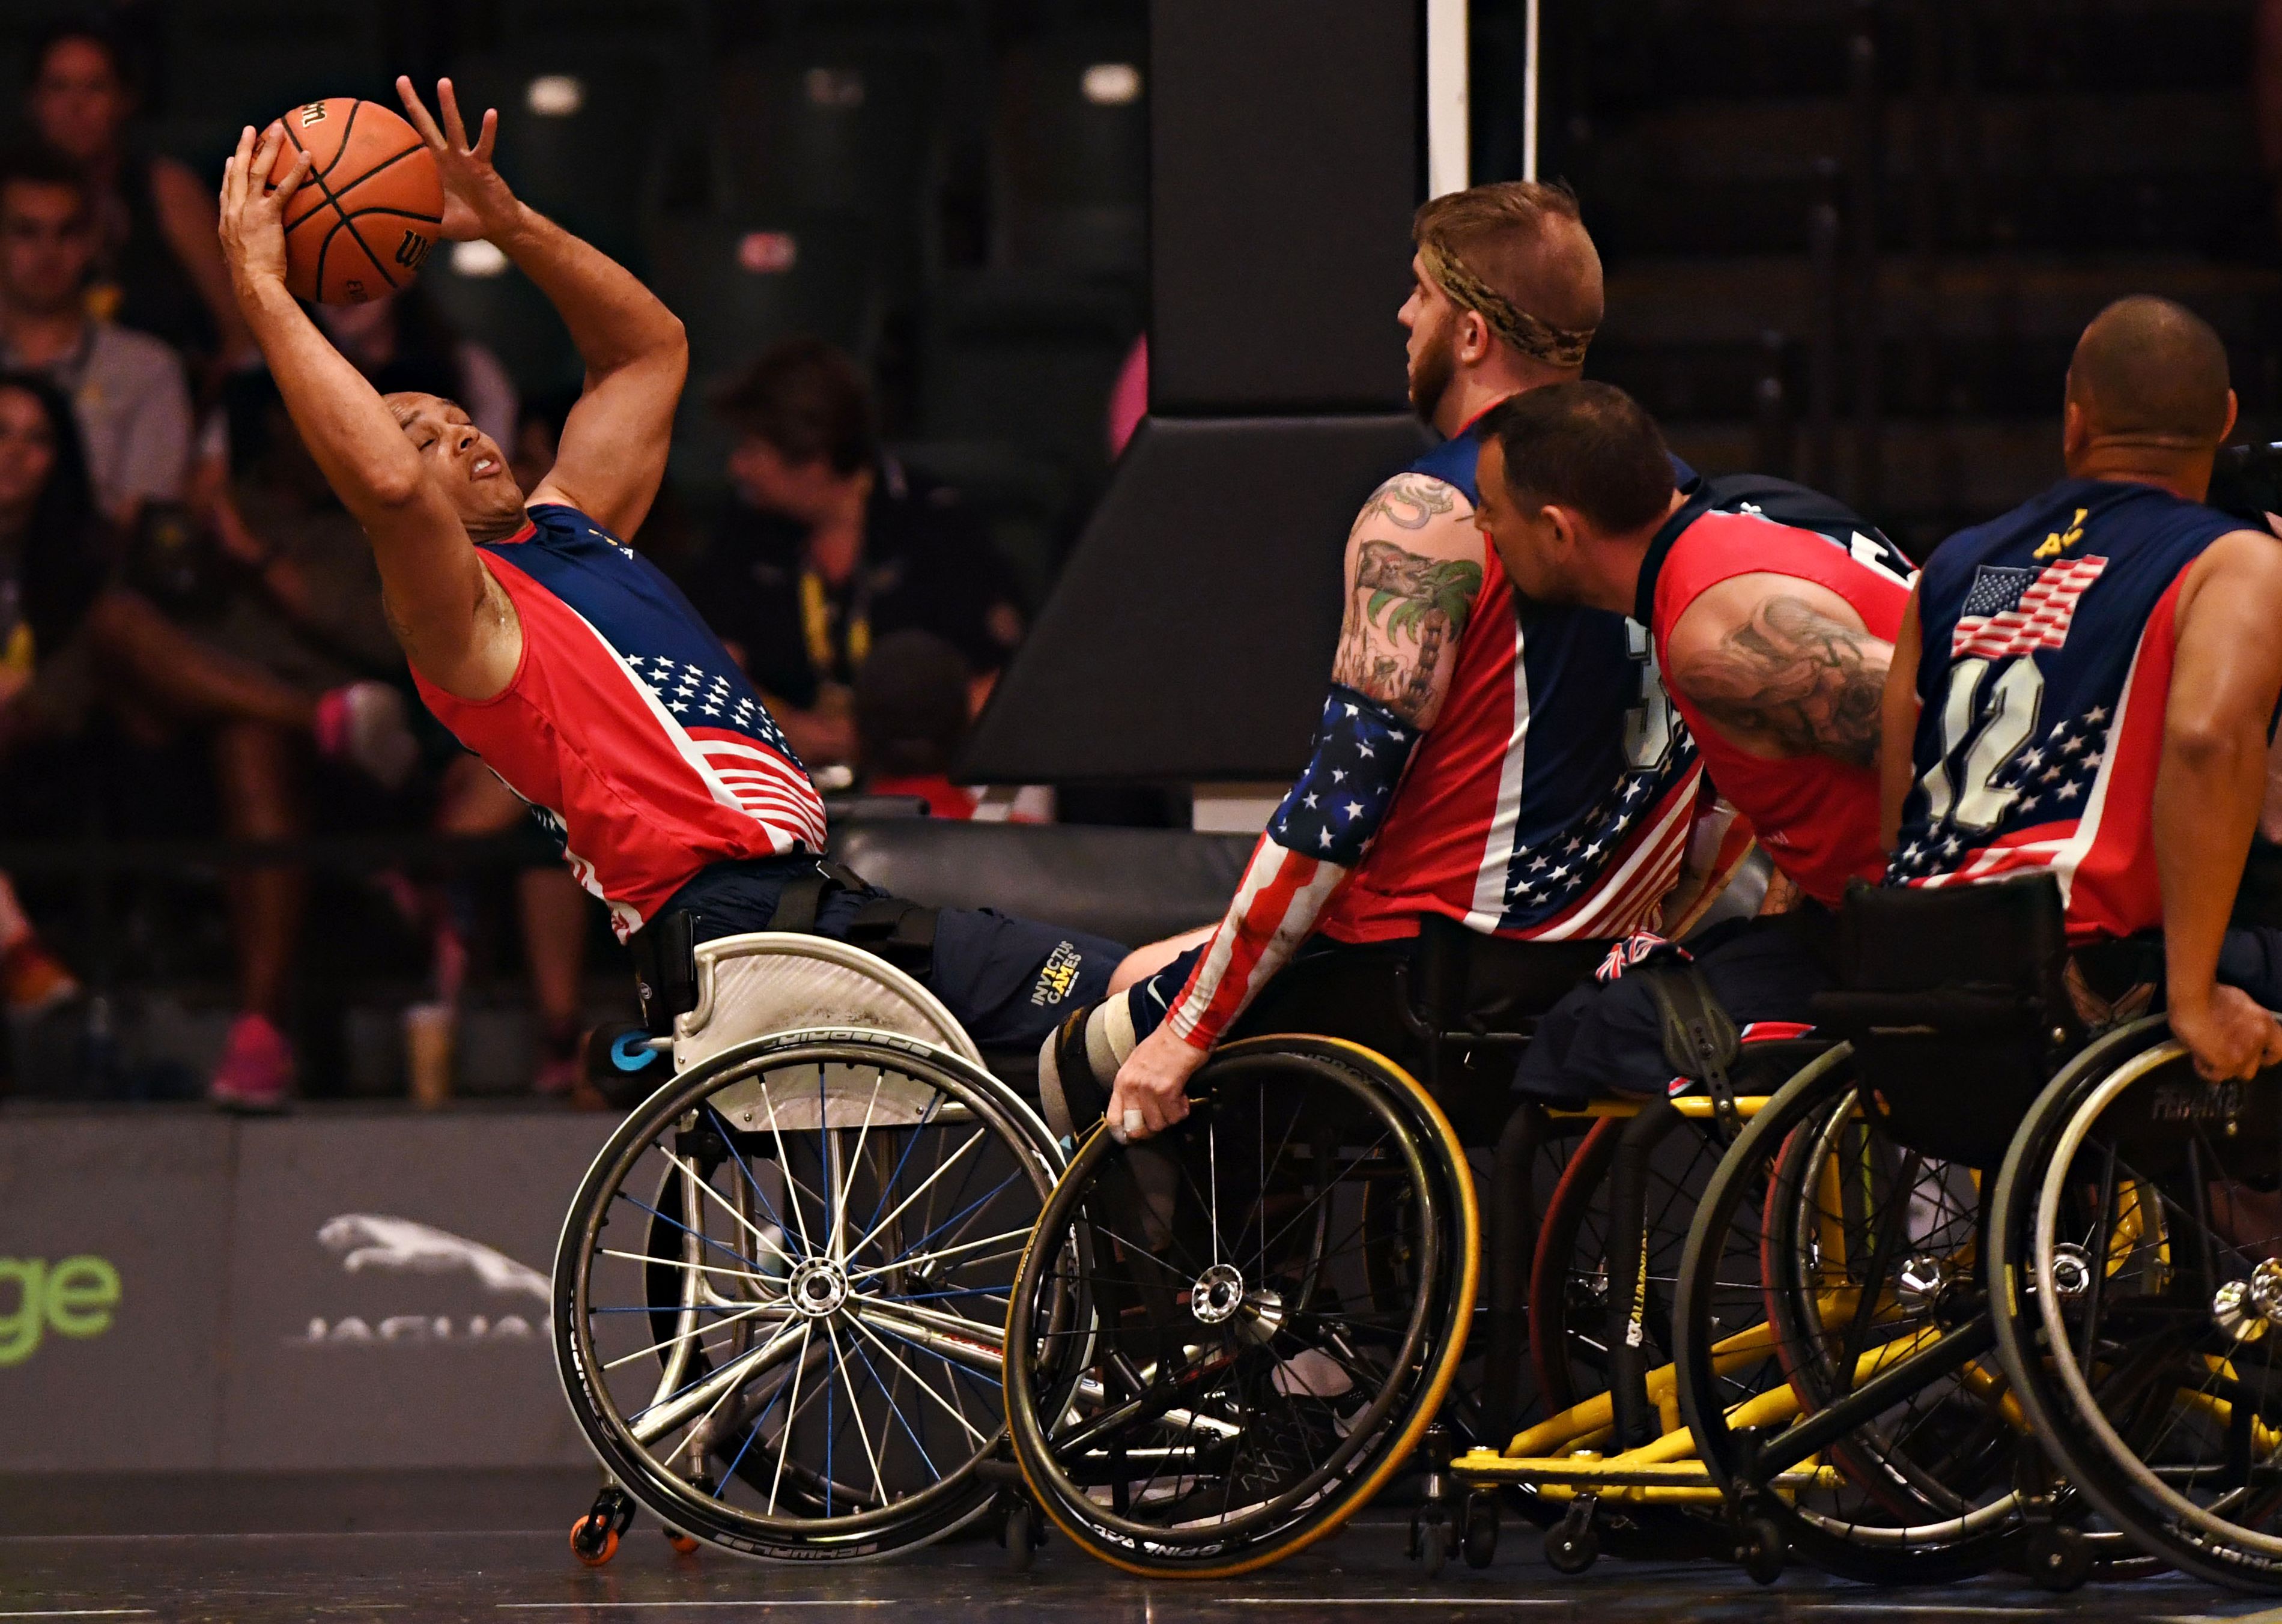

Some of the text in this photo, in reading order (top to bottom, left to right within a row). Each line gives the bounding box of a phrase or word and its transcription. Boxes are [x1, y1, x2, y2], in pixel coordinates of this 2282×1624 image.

[1921, 655, 2045, 832] 12
[1030, 940, 1074, 1006] INVICTUS
[1047, 953, 1081, 1004] GAMES
